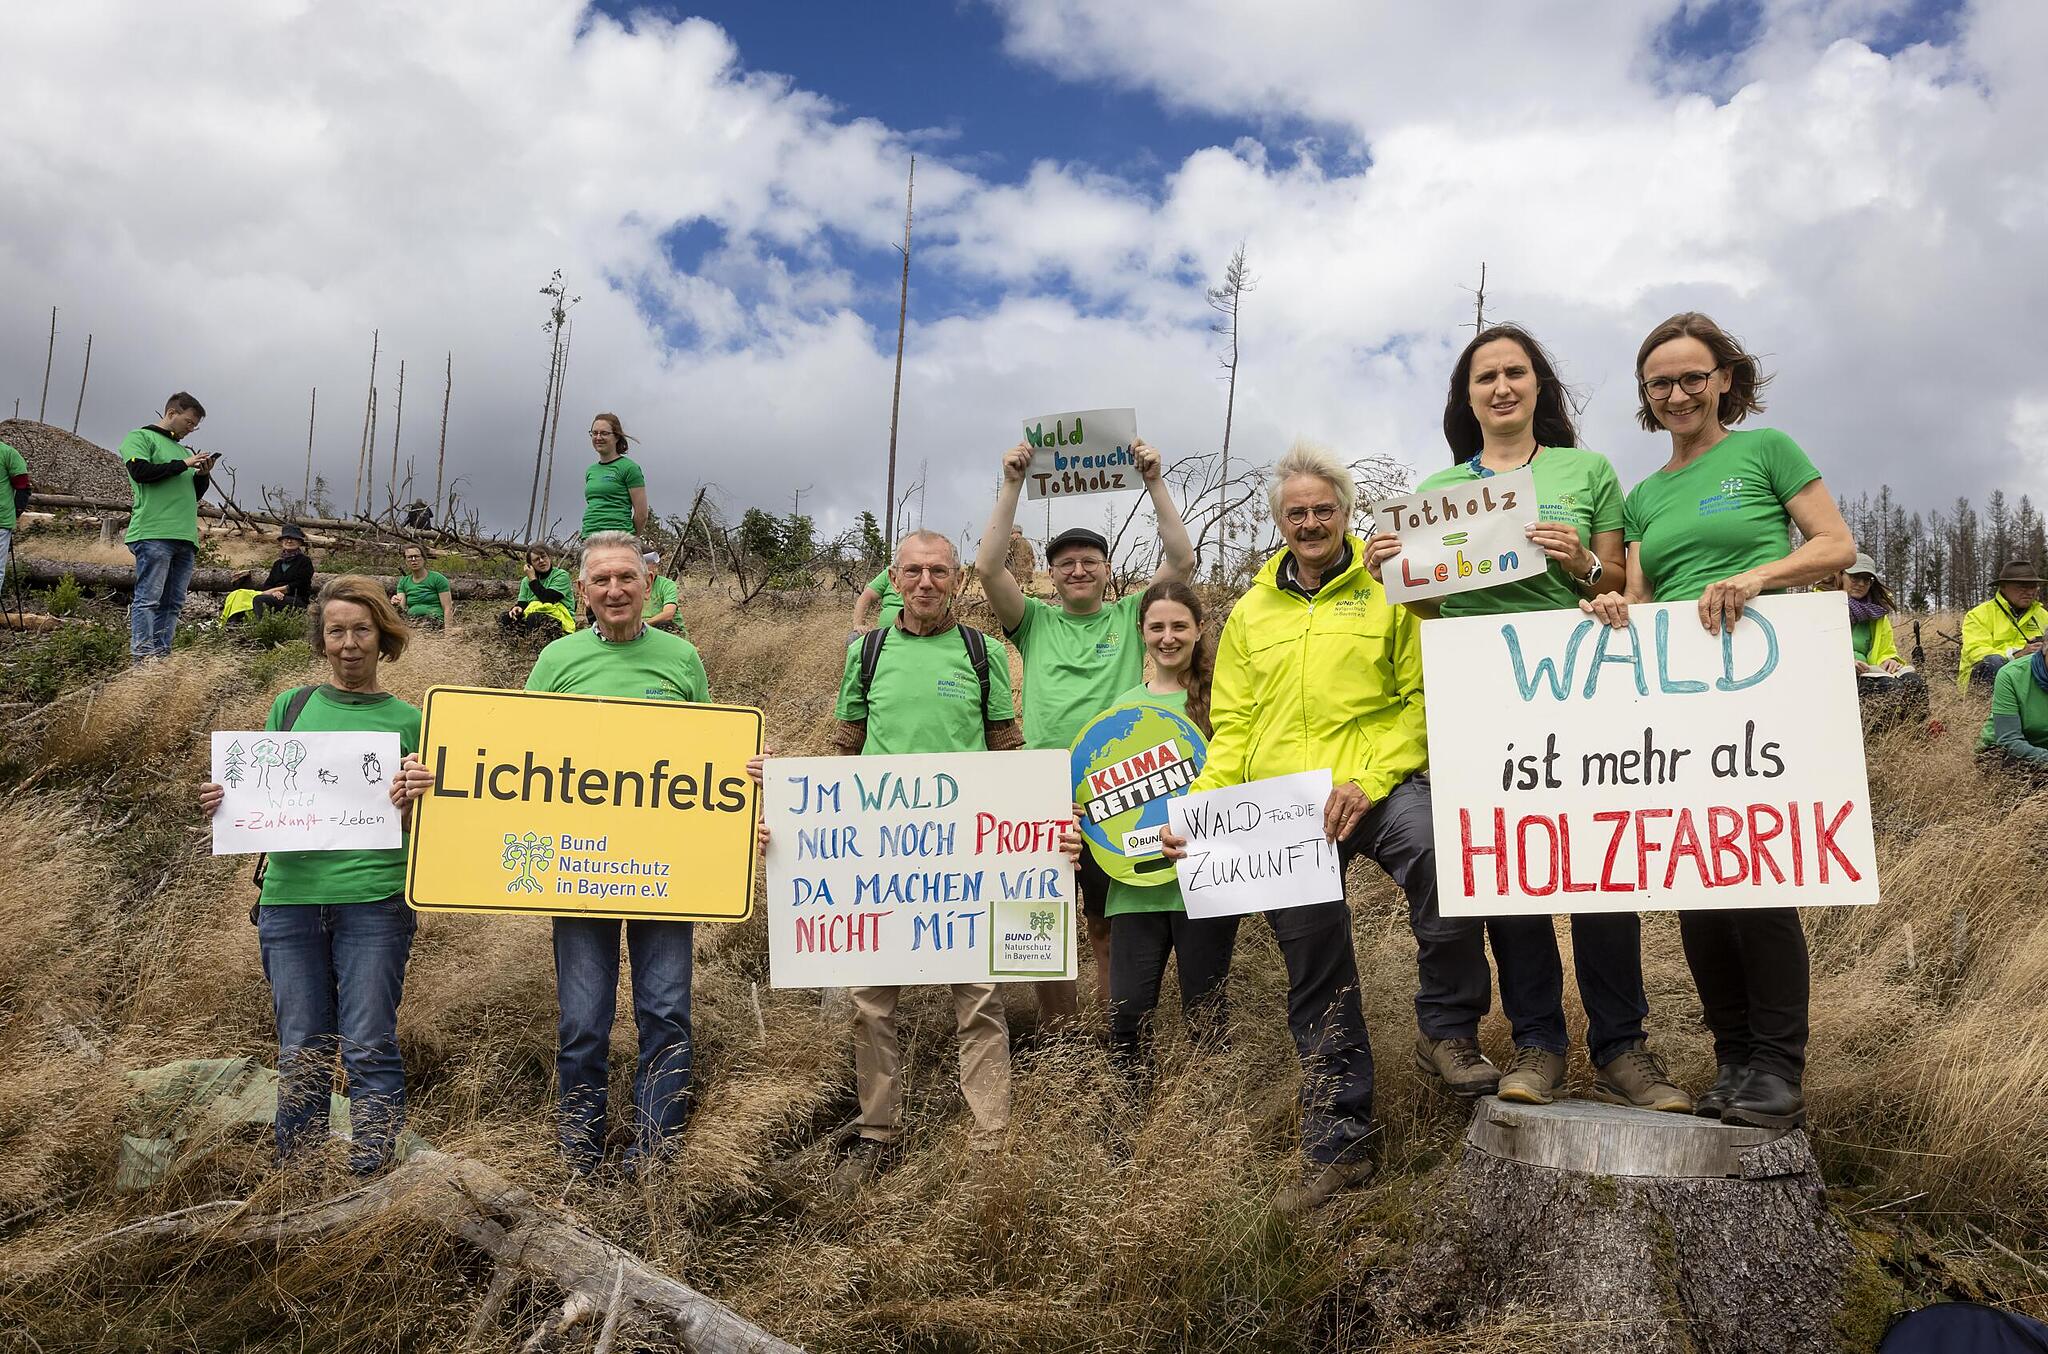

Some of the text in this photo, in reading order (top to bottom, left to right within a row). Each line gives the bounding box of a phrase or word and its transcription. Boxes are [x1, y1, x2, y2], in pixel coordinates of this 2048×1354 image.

[1026, 417, 1084, 448] Wald
[1032, 470, 1126, 496] Totholz
[1382, 487, 1517, 531] Totholz
[1402, 550, 1519, 588] Leben
[1501, 605, 1780, 702] WALD
[1091, 744, 1178, 795] KLIMA
[1502, 720, 1786, 791] ist mehr als
[433, 746, 746, 813] Lichtenfels
[854, 771, 959, 811] WALD
[1089, 761, 1196, 823] RETTEN!
[267, 790, 315, 808] Wald
[1183, 801, 1261, 840] WALD
[1290, 803, 1316, 817] DIE
[560, 834, 607, 852] Bund
[797, 825, 863, 861] NUR
[879, 820, 956, 859] NOCH
[1459, 799, 1863, 898] HOLZFABRIK
[559, 856, 670, 876] Naturschutz
[556, 877, 668, 899] in Bayern e.V.
[792, 877, 835, 907] DA
[853, 870, 984, 905] MACHEN
[1004, 933, 1032, 941] BUND
[1004, 943, 1052, 951] Naturschutz
[1013, 953, 1038, 961] Bayern
